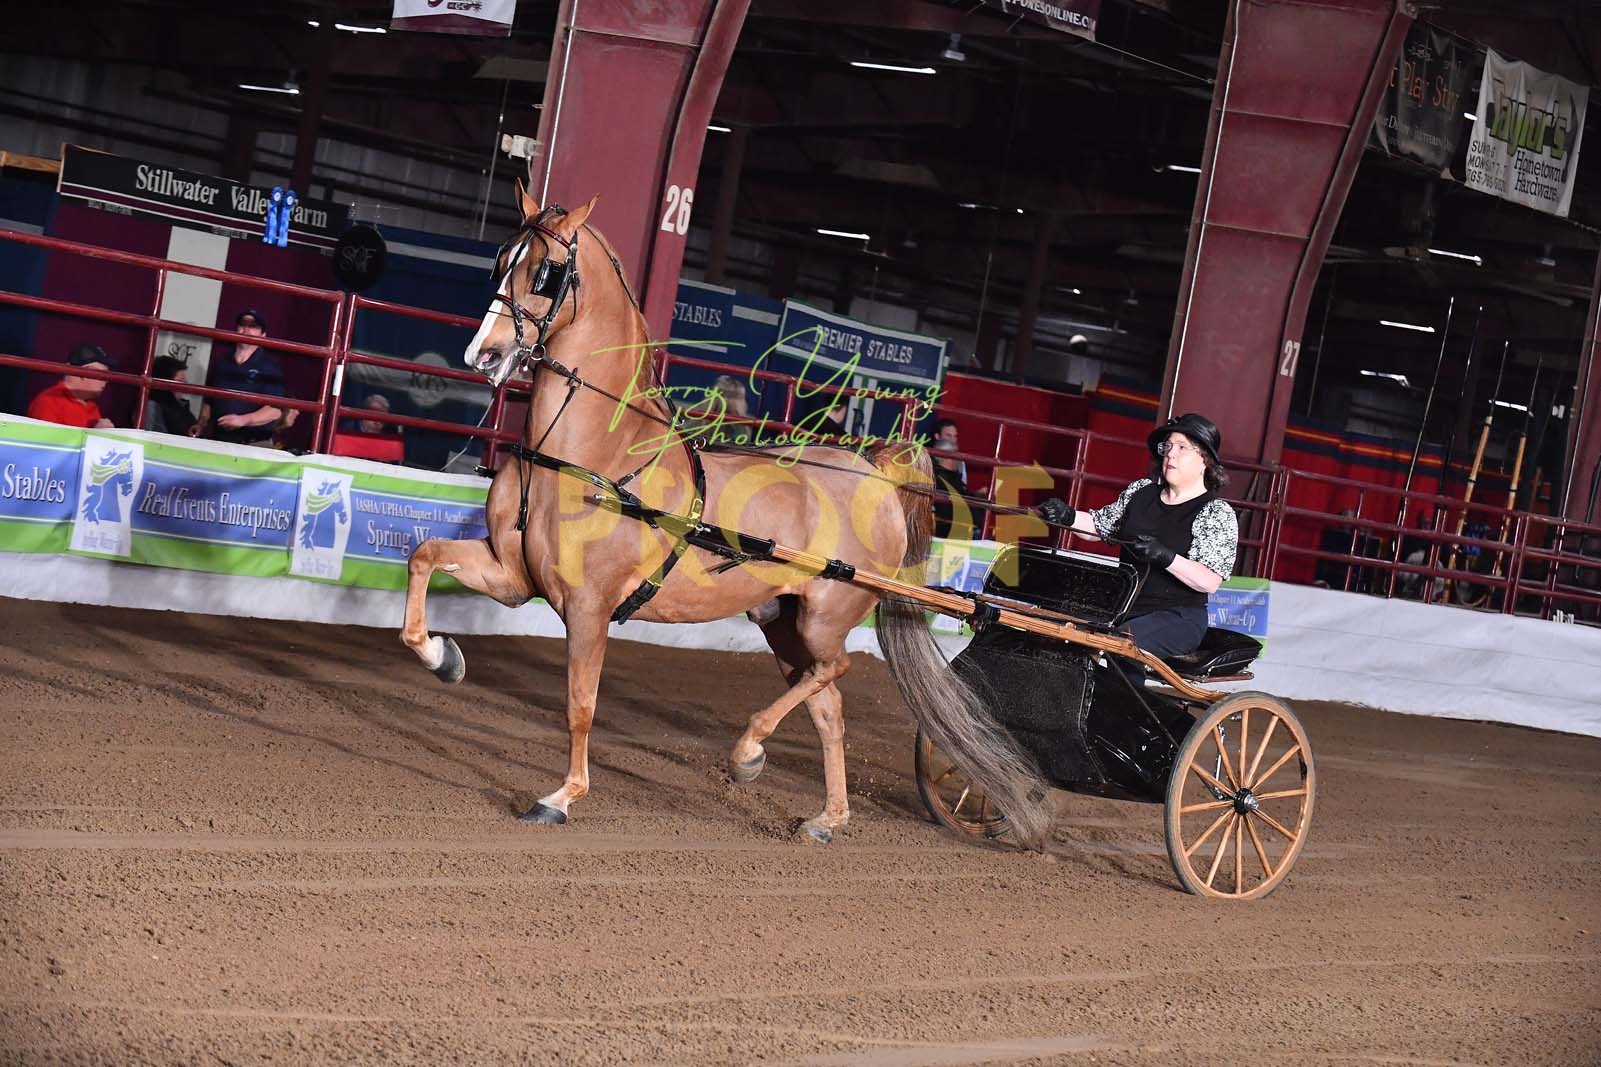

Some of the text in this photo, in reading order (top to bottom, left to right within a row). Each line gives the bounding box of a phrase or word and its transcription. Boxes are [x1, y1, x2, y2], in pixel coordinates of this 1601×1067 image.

[135, 164, 219, 206] Stillwater
[1514, 150, 1562, 184] Hometown
[1514, 171, 1559, 202] Hardware
[660, 184, 694, 236] 26
[671, 302, 723, 328] STABLES
[814, 324, 864, 355] PREMIER
[866, 339, 914, 365] STABLES
[1280, 339, 1301, 378] 27
[1, 463, 66, 504] Stables
[137, 482, 293, 538] Real Events Enterprises
[367, 519, 412, 557] Spring
